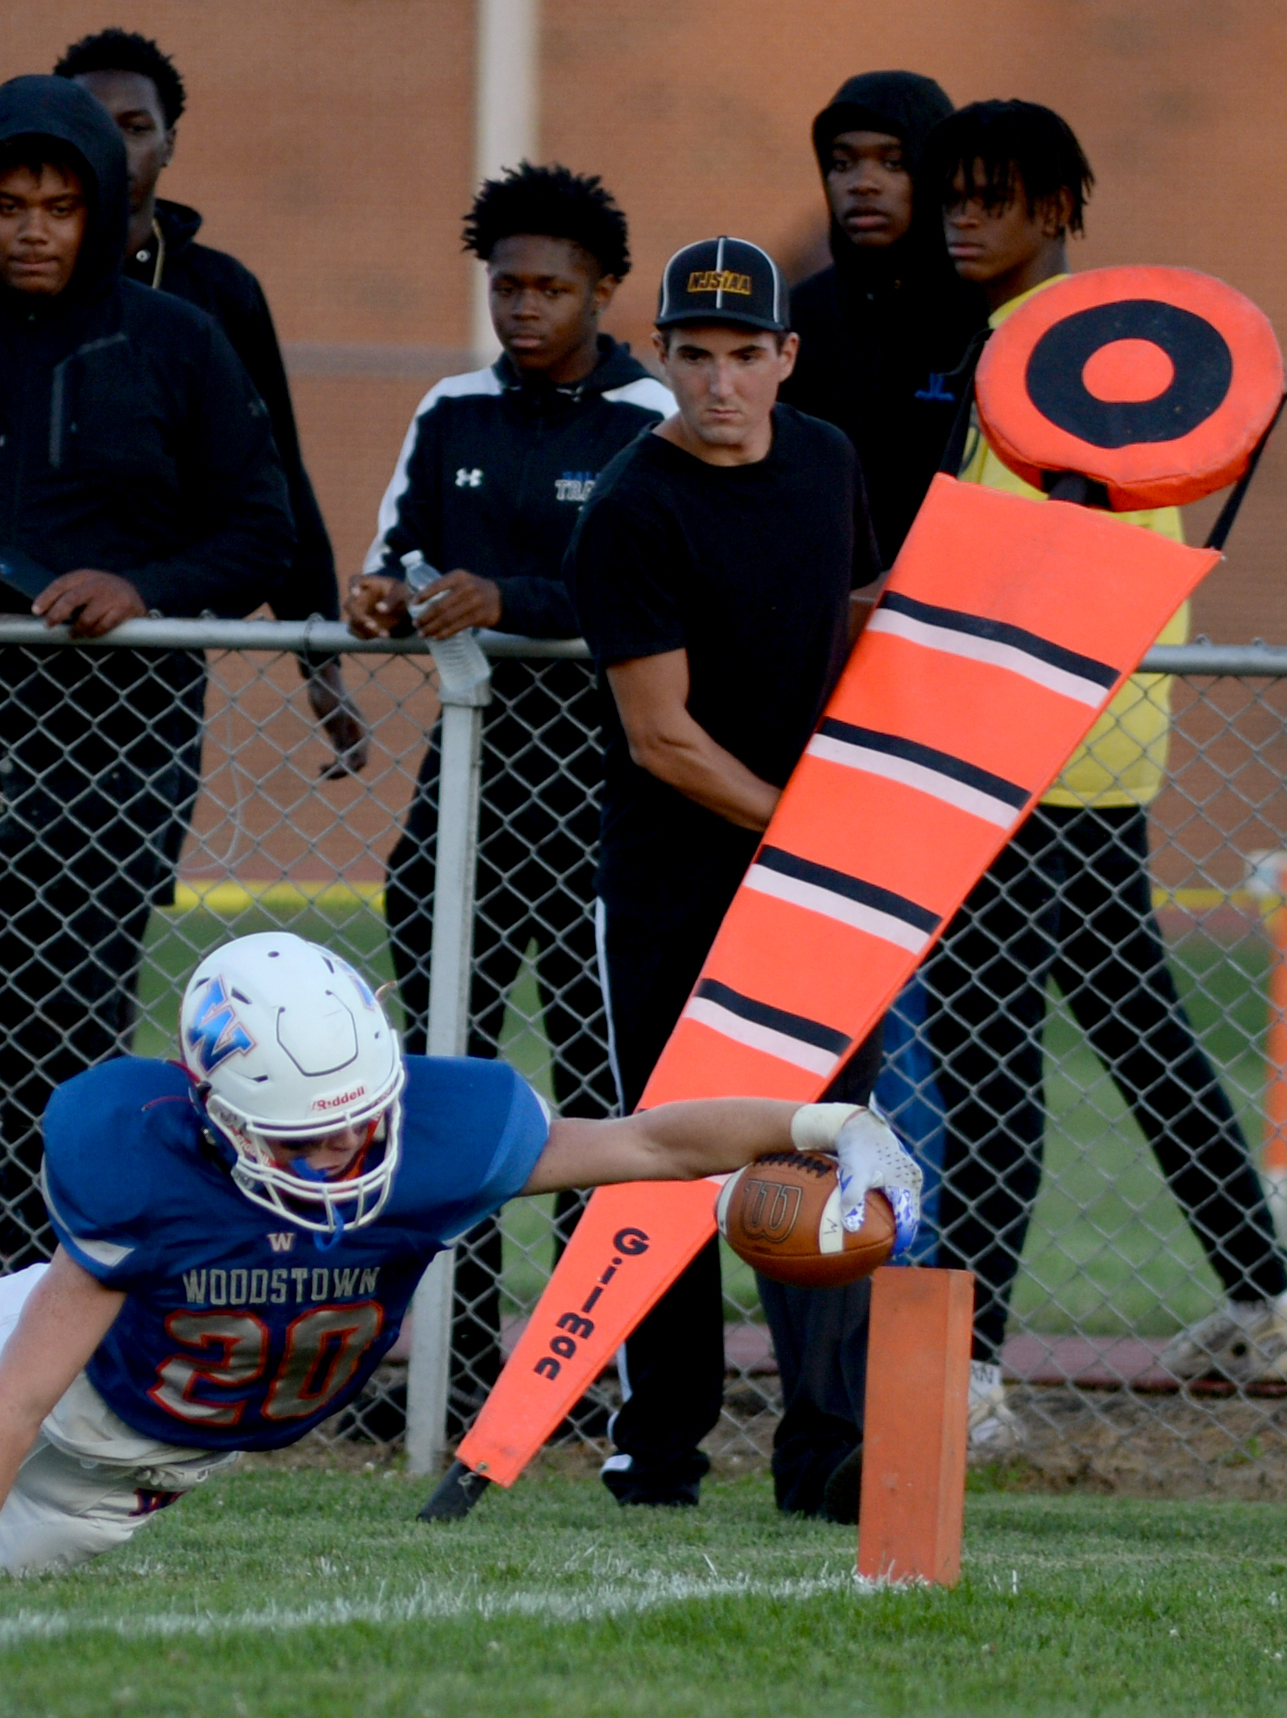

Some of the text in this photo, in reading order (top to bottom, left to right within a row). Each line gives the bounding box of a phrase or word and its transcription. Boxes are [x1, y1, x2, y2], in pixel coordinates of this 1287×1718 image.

[186, 974, 258, 1078] W
[311, 1086, 366, 1111] Riddell
[266, 1232, 296, 1252] W
[182, 1266, 382, 1306] WOODSTOWN
[533, 1226, 651, 1382] Gilman
[146, 1299, 387, 1428] 20
